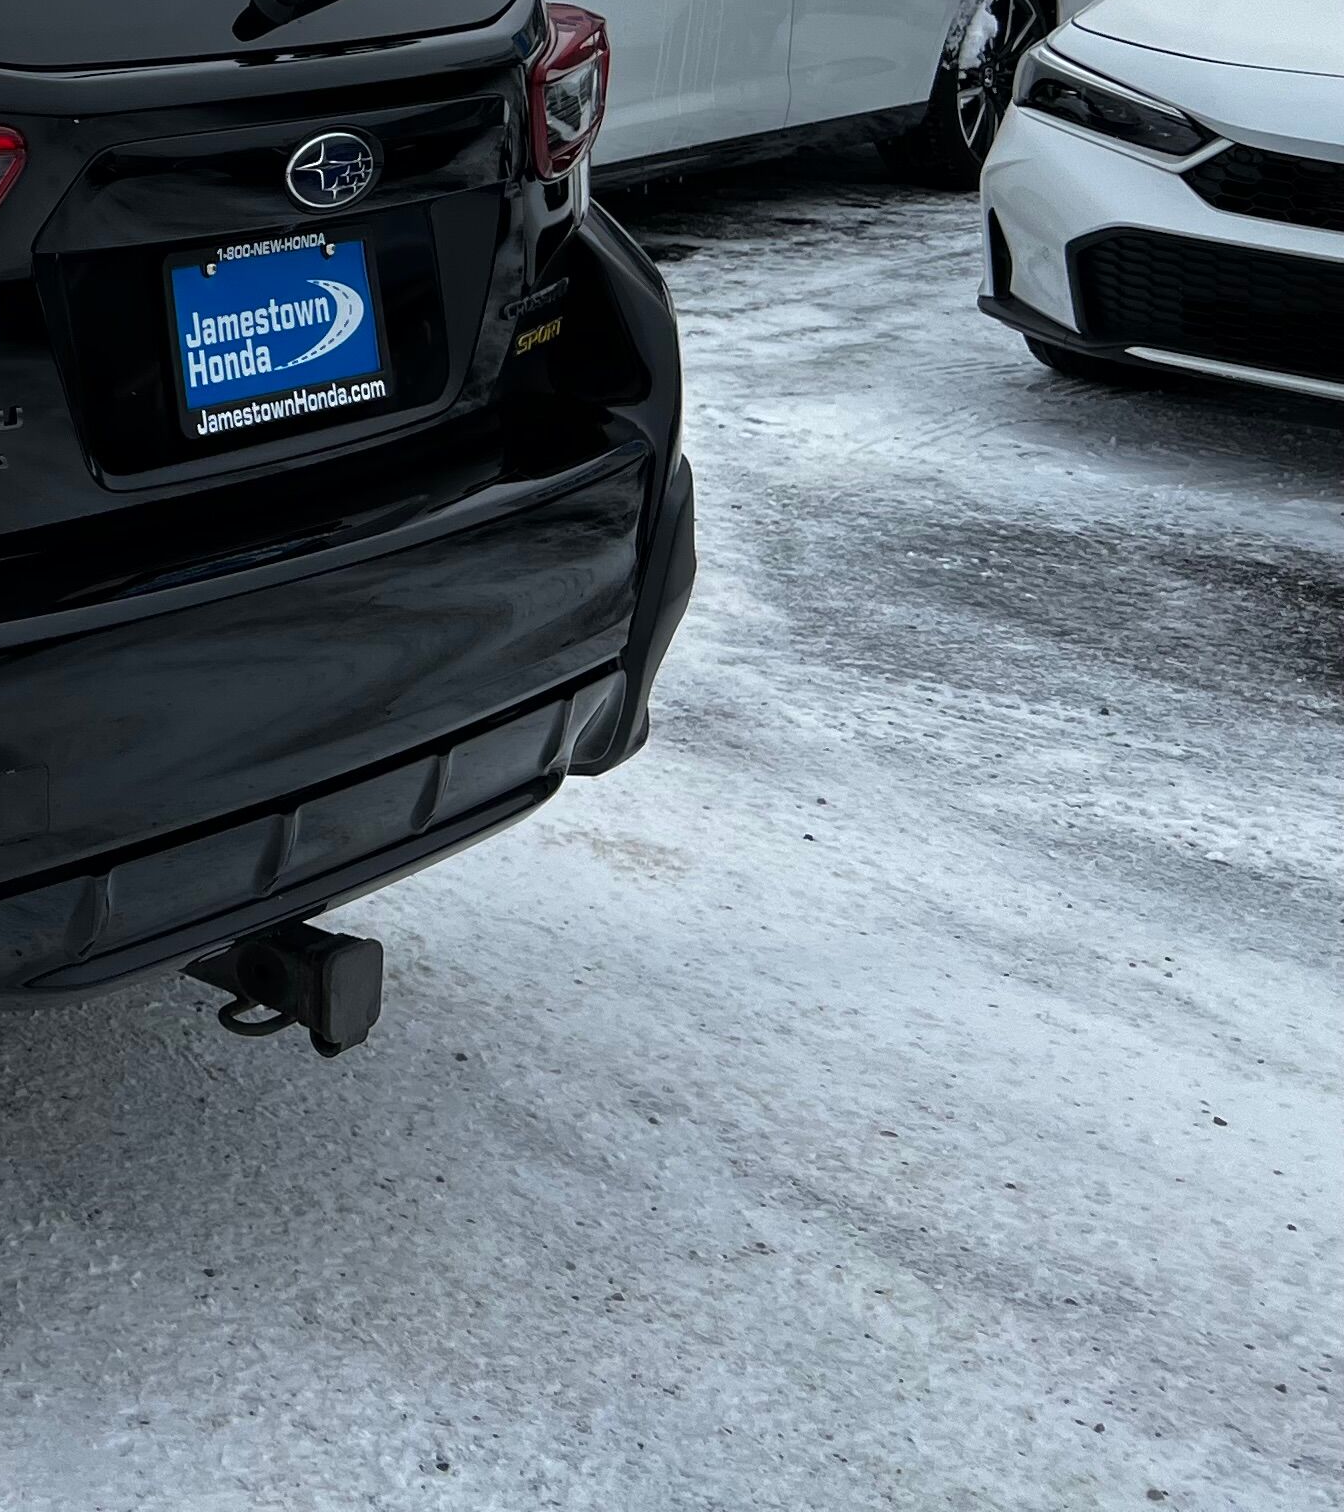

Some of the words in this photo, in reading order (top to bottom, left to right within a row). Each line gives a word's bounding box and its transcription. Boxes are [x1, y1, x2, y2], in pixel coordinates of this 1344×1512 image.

[216, 232, 326, 262] 1-800-NEW-HONDA
[185, 296, 331, 349] Jamestown
[516, 316, 563, 355] SPORT
[187, 339, 273, 388] Honda
[196, 379, 387, 436] JamestownHonda.com
